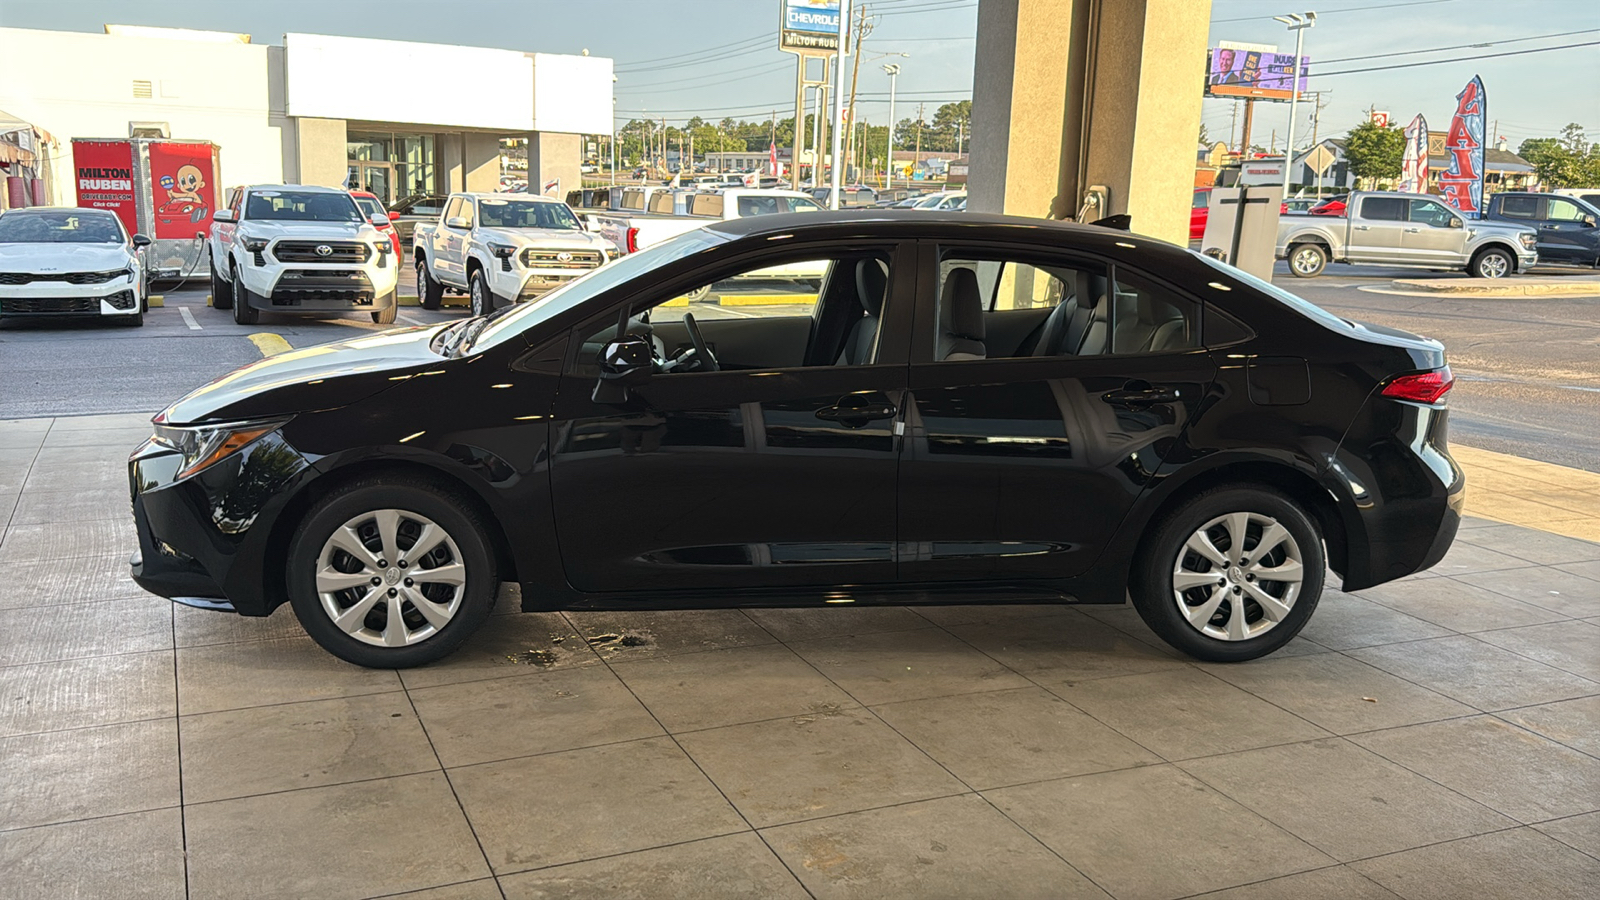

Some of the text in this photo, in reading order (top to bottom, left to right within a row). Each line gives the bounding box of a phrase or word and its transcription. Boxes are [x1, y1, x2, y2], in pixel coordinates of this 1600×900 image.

[789, 12, 839, 25] CHEVROLE
[786, 35, 839, 48] MILTON RUBE
[79, 168, 130, 178] MILTON
[79, 179, 132, 190] RUBEN
